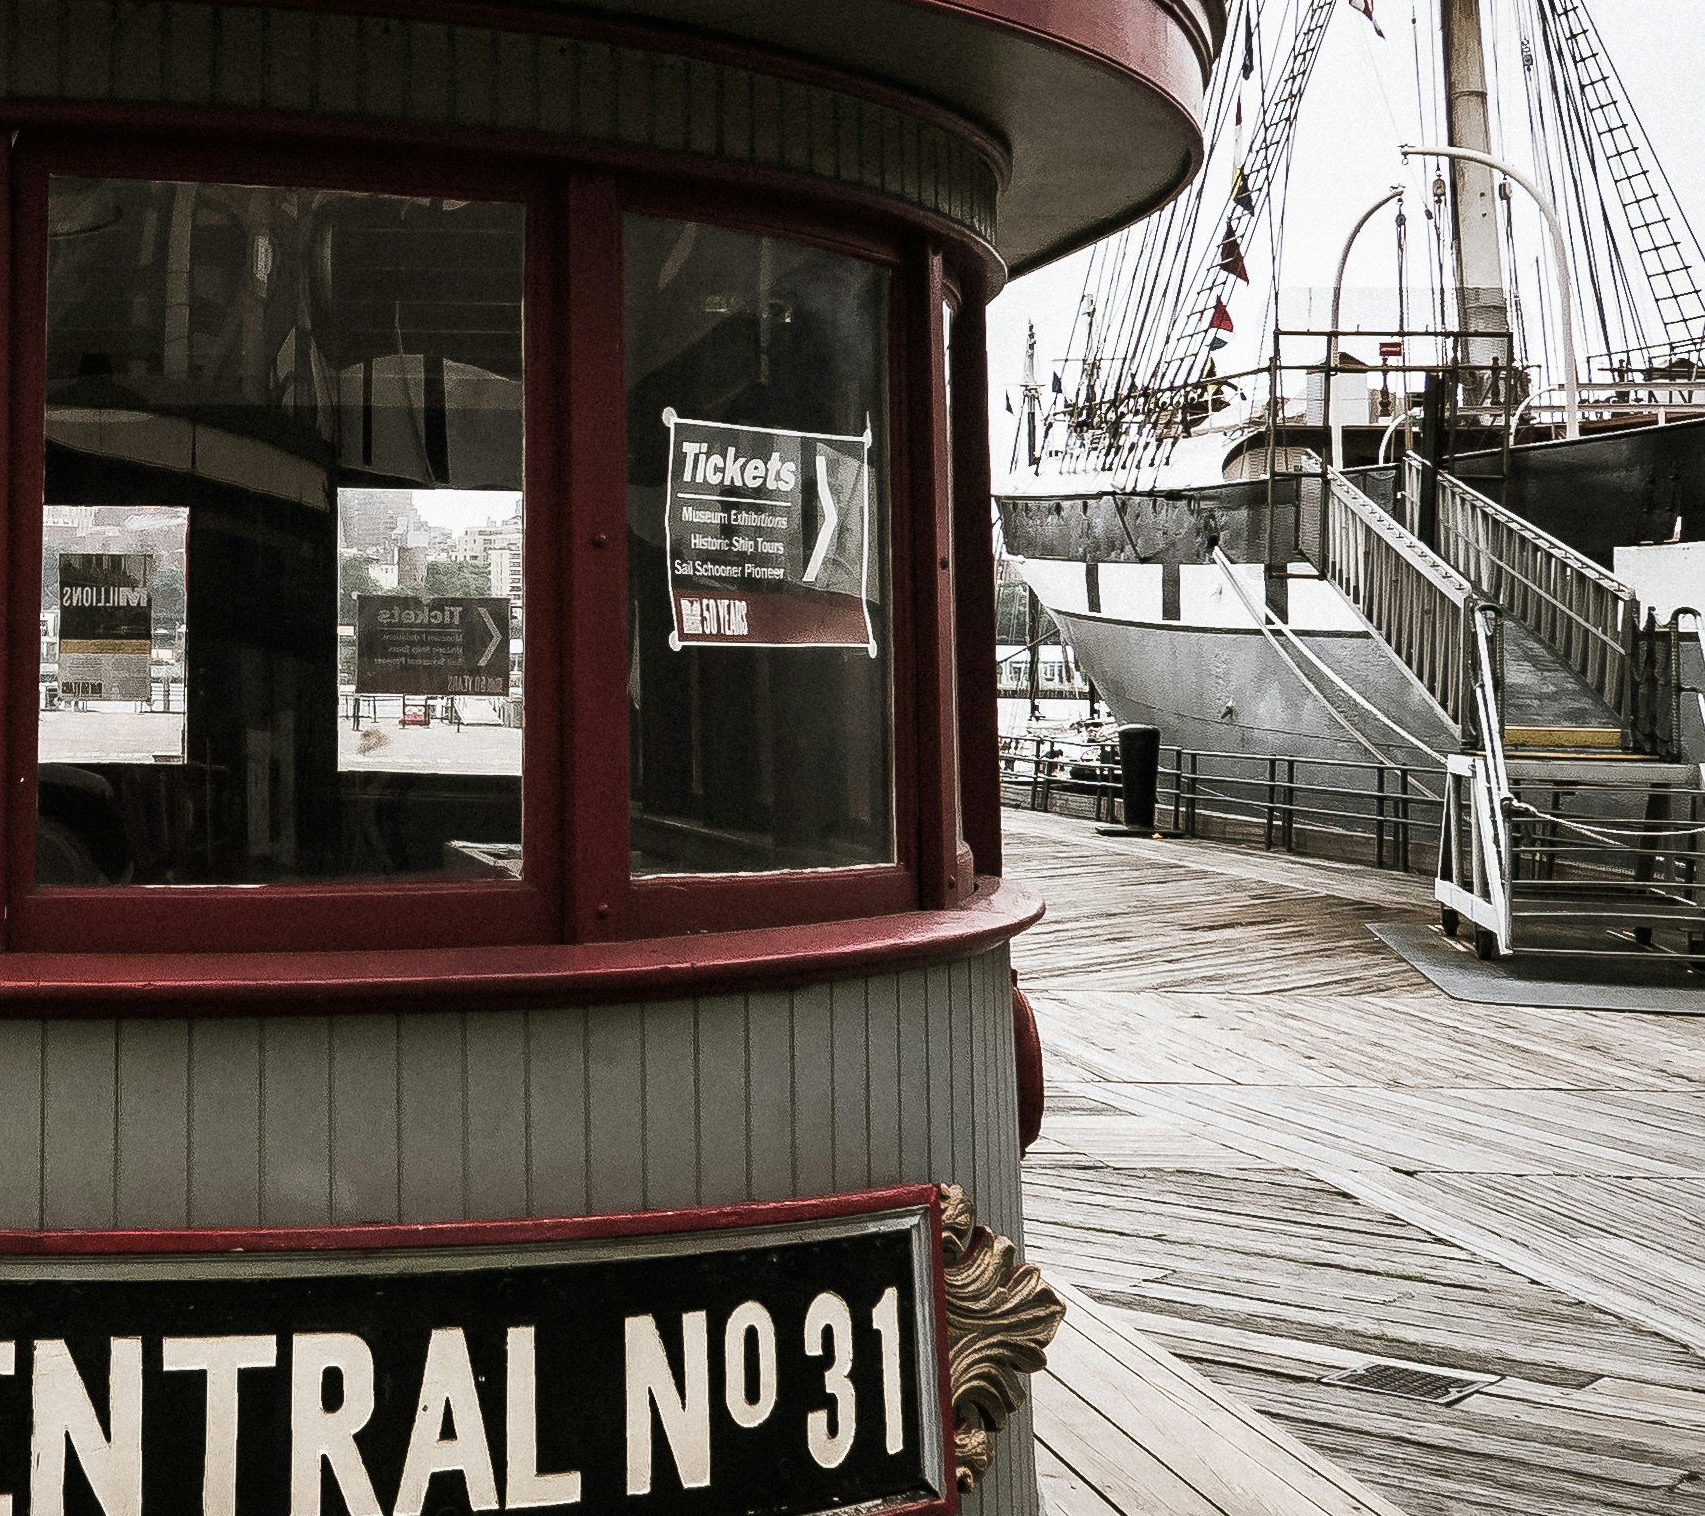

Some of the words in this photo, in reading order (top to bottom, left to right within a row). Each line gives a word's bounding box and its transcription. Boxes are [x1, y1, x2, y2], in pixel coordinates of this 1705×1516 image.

[682, 442, 796, 491] Tickets
[682, 507, 728, 525] Museum
[731, 510, 788, 529] Exhibitions
[691, 534, 729, 550] Historic
[731, 537, 754, 555] Ship
[757, 539, 784, 554] Tours
[674, 560, 693, 575] Sail
[695, 561, 741, 578] Schooner
[745, 564, 785, 579] Pioneer
[702, 598, 717, 635] 50
[717, 599, 748, 636] YEARS
[802, 1286, 905, 1469] 31
